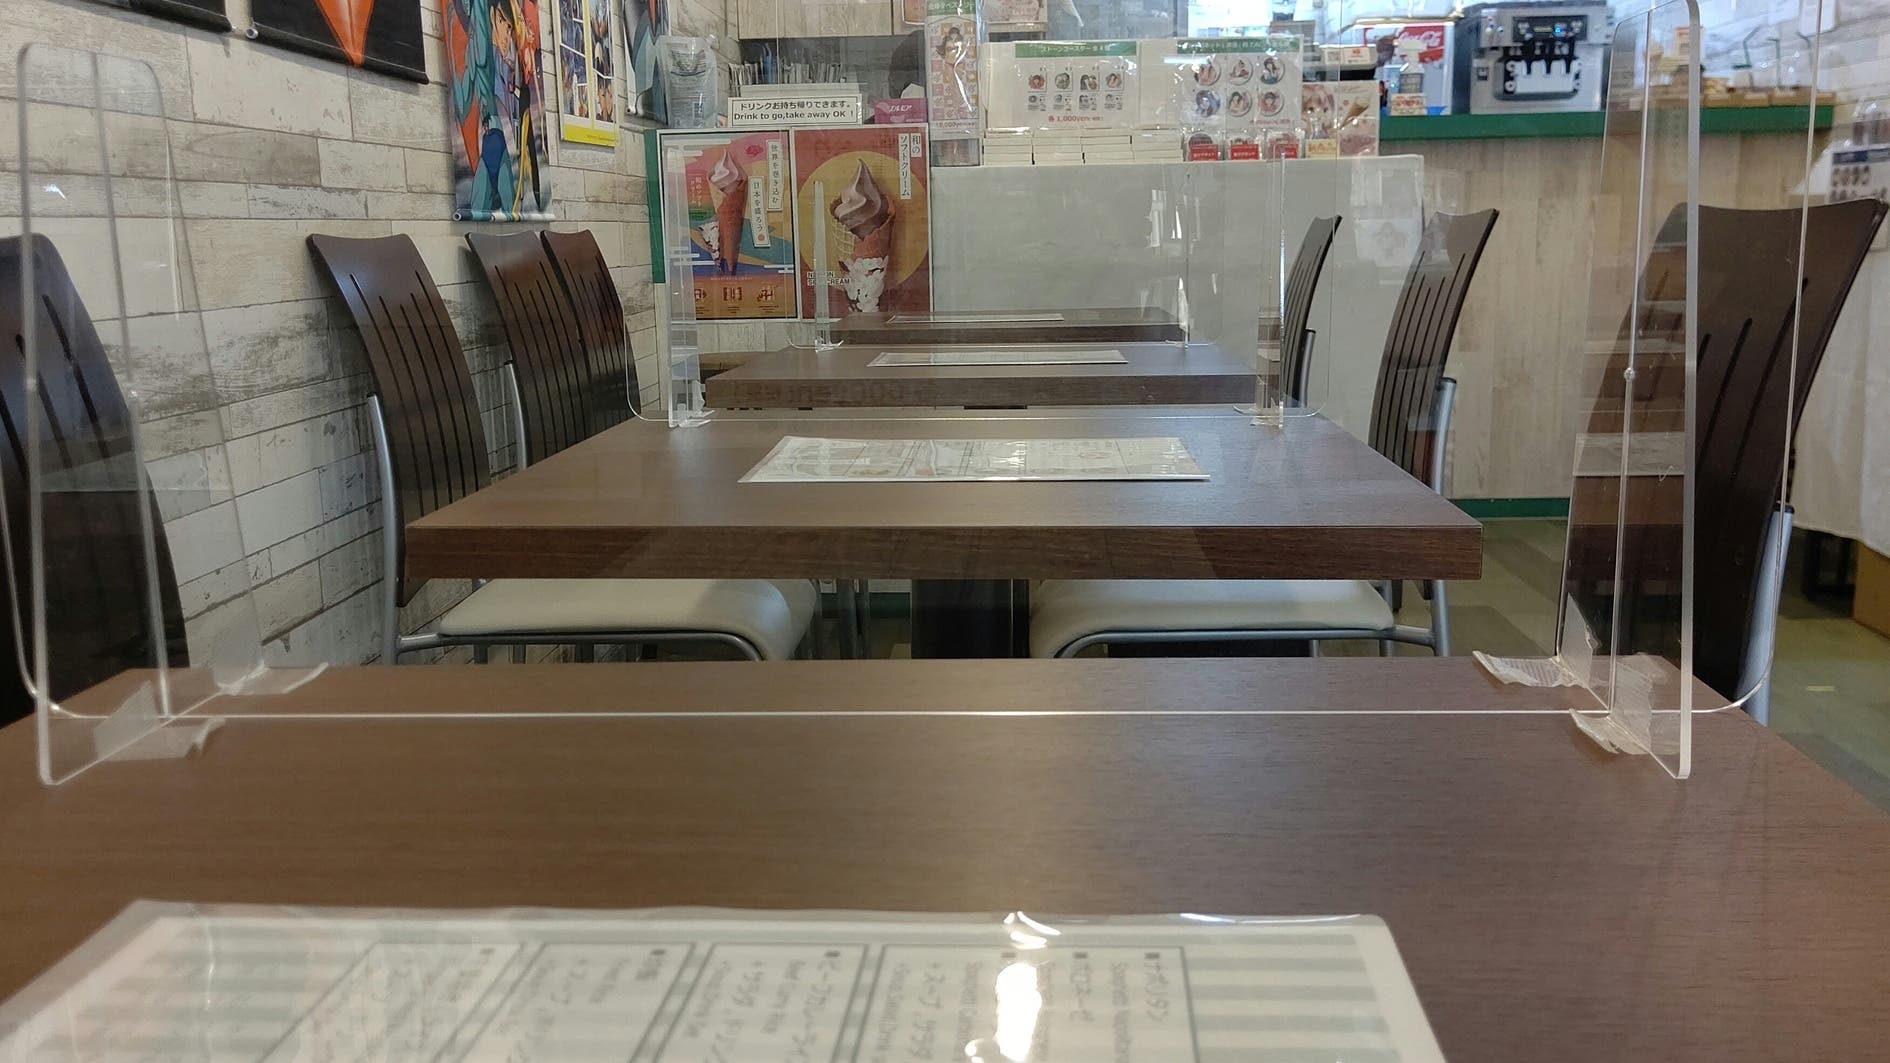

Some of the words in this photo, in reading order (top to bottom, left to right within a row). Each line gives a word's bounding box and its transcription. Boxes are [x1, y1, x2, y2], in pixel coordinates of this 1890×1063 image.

[740, 100, 851, 111] ドリンクお持ち帰りできます。
[734, 111, 760, 120] Drink
[772, 111, 805, 121] go,take
[807, 111, 831, 120] away
[912, 135, 921, 154] 和の
[900, 135, 910, 196] ソフトクリーム
